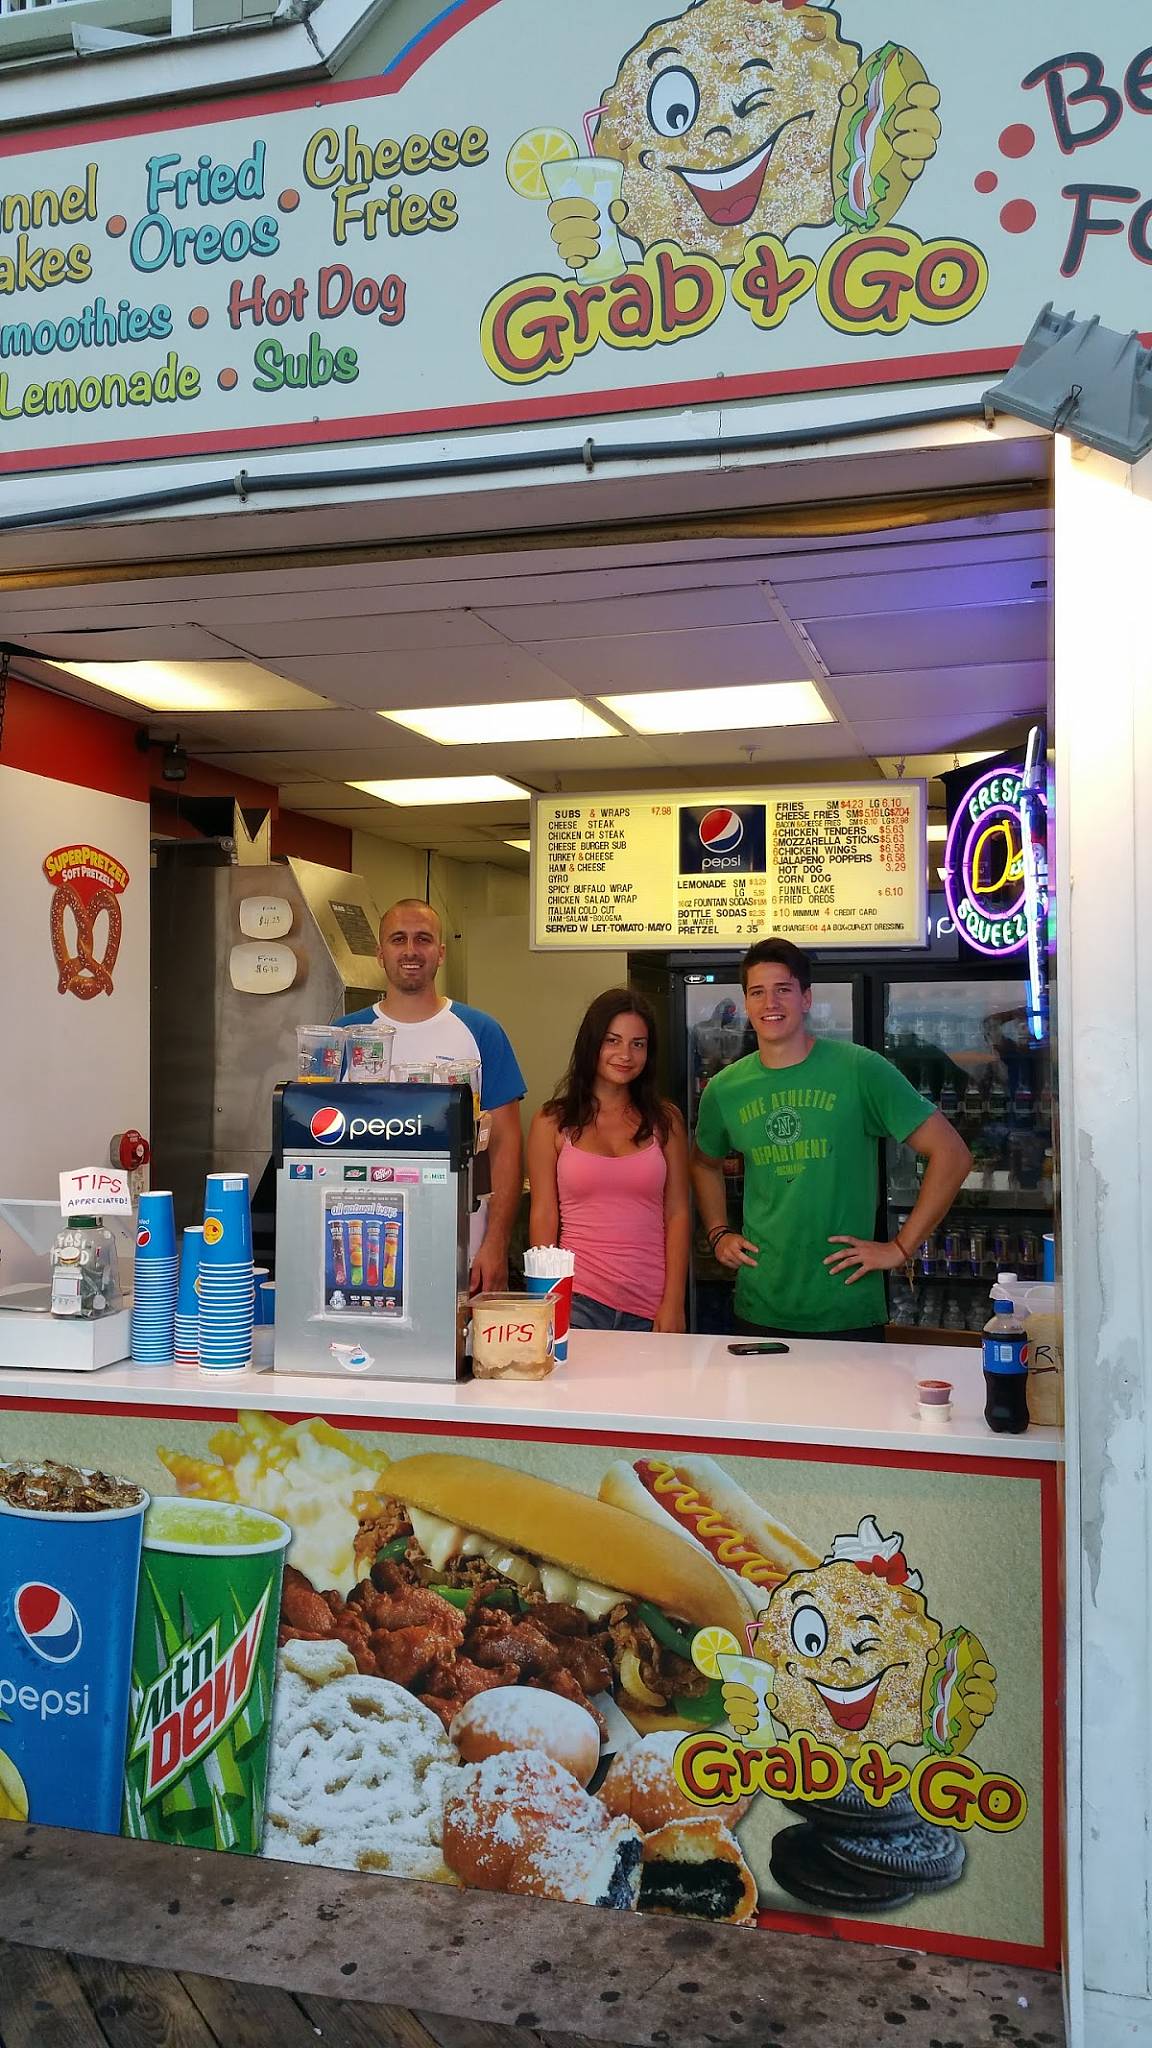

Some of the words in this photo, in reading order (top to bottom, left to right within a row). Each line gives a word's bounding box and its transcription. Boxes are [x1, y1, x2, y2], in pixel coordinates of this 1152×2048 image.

[304, 124, 489, 190] Cheese
[146, 140, 266, 213] Fried
[0, 162, 98, 232] nnel
[332, 182, 458, 245] Fries
[130, 213, 280, 272] Oreos
[228, 275, 309, 329] Hot
[317, 263, 407, 327] Dog
[489, 247, 717, 374] Grab
[738, 242, 808, 320] &
[826, 233, 982, 328] Go
[253, 331, 360, 392] Subs
[0, 351, 201, 420] Lemonade
[776, 802, 804, 811] FRIES
[826, 800, 839, 810] SM
[869, 799, 880, 808] LG
[555, 809, 581, 819] SUBS
[589, 809, 596, 818] &
[600, 808, 631, 818] WRAPS
[775, 811, 809, 821] CHEESE
[813, 810, 840, 819] FRIES
[846, 809, 858, 819] SM
[880, 808, 890, 817] LG
[548, 821, 578, 830] CHEESE
[588, 820, 615, 829] STEAK
[824, 819, 841, 827] FRIES
[882, 817, 891, 825] LG
[548, 831, 582, 840] CHICKEN
[585, 831, 595, 840] CH
[599, 830, 625, 839] STEAK
[777, 828, 819, 838] CHICKEN
[824, 826, 867, 836] TENDERS
[879, 825, 904, 834] $5.63
[548, 842, 576, 851] CHEESE
[580, 841, 610, 851] BURGER
[611, 841, 627, 850] SUB
[778, 837, 841, 847] MOZZARELLA
[845, 834, 880, 845] STICKS
[879, 834, 905, 844] $5.63
[778, 846, 819, 856] CHICKEN
[825, 845, 858, 855] WINGS
[879, 844, 905, 853] $6.58
[549, 853, 576, 862] TURKEY
[701, 854, 741, 871] pepsi
[777, 855, 825, 865] JALAPENO
[829, 854, 873, 864] POPPERS
[879, 853, 906, 863] $6.58
[549, 863, 566, 872] HAM
[568, 863, 575, 872] &
[577, 863, 606, 872] CHEESE
[778, 865, 798, 875] HOT
[803, 865, 823, 874] DOG
[885, 862, 906, 873] 3.29
[61, 867, 81, 882] SOFT
[80, 865, 115, 889] PRETZELS
[548, 874, 569, 883] GYRO
[777, 874, 804, 884] CORN
[810, 874, 832, 883] DOG
[548, 885, 570, 894] SPICY
[573, 884, 606, 893] BUFFALO
[609, 883, 633, 893] WRAP
[677, 879, 727, 889] LEMONADE
[733, 879, 746, 888] SM
[779, 885, 812, 895] FUNNEL
[813, 884, 835, 894] CAKE
[734, 888, 745, 897] LG
[547, 896, 580, 905] CHICKEN
[584, 895, 610, 904] SALAD
[613, 894, 638, 903] WRAP
[693, 898, 727, 907] FOUNTAIN
[728, 897, 753, 907] SODAS
[779, 895, 803, 905] FRIED
[808, 895, 835, 904] OREOS
[548, 906, 576, 915] ITALIAN
[578, 906, 598, 915] COLD
[600, 905, 615, 914] CUT
[678, 909, 711, 918] BOTTLE
[716, 908, 747, 917] SODAS
[792, 909, 820, 917] MINIMUM
[833, 908, 856, 916] CREDIT
[859, 908, 877, 916] CARD
[874, 923, 904, 931] DRESSING
[957, 897, 1026, 947] SQUEEZ
[545, 924, 578, 933] SERVED
[678, 925, 719, 934] PRETZEL
[739, 1096, 767, 1125] NIKE
[771, 1089, 838, 1112] ATHLETIC
[349, 1113, 422, 1141] pepsi
[751, 1138, 828, 1167] DEPARTMENT
[71, 1174, 122, 1193] TIPS
[67, 1197, 128, 1208] APPRECIATED!
[330, 1203, 343, 1217] all
[342, 1202, 375, 1215] natural
[482, 1323, 535, 1343] TIPS
[142, 1639, 214, 1740] Mtn
[678, 1732, 843, 1802] Grab
[856, 1745, 907, 1802] &
[914, 1758, 1025, 1828] Go
